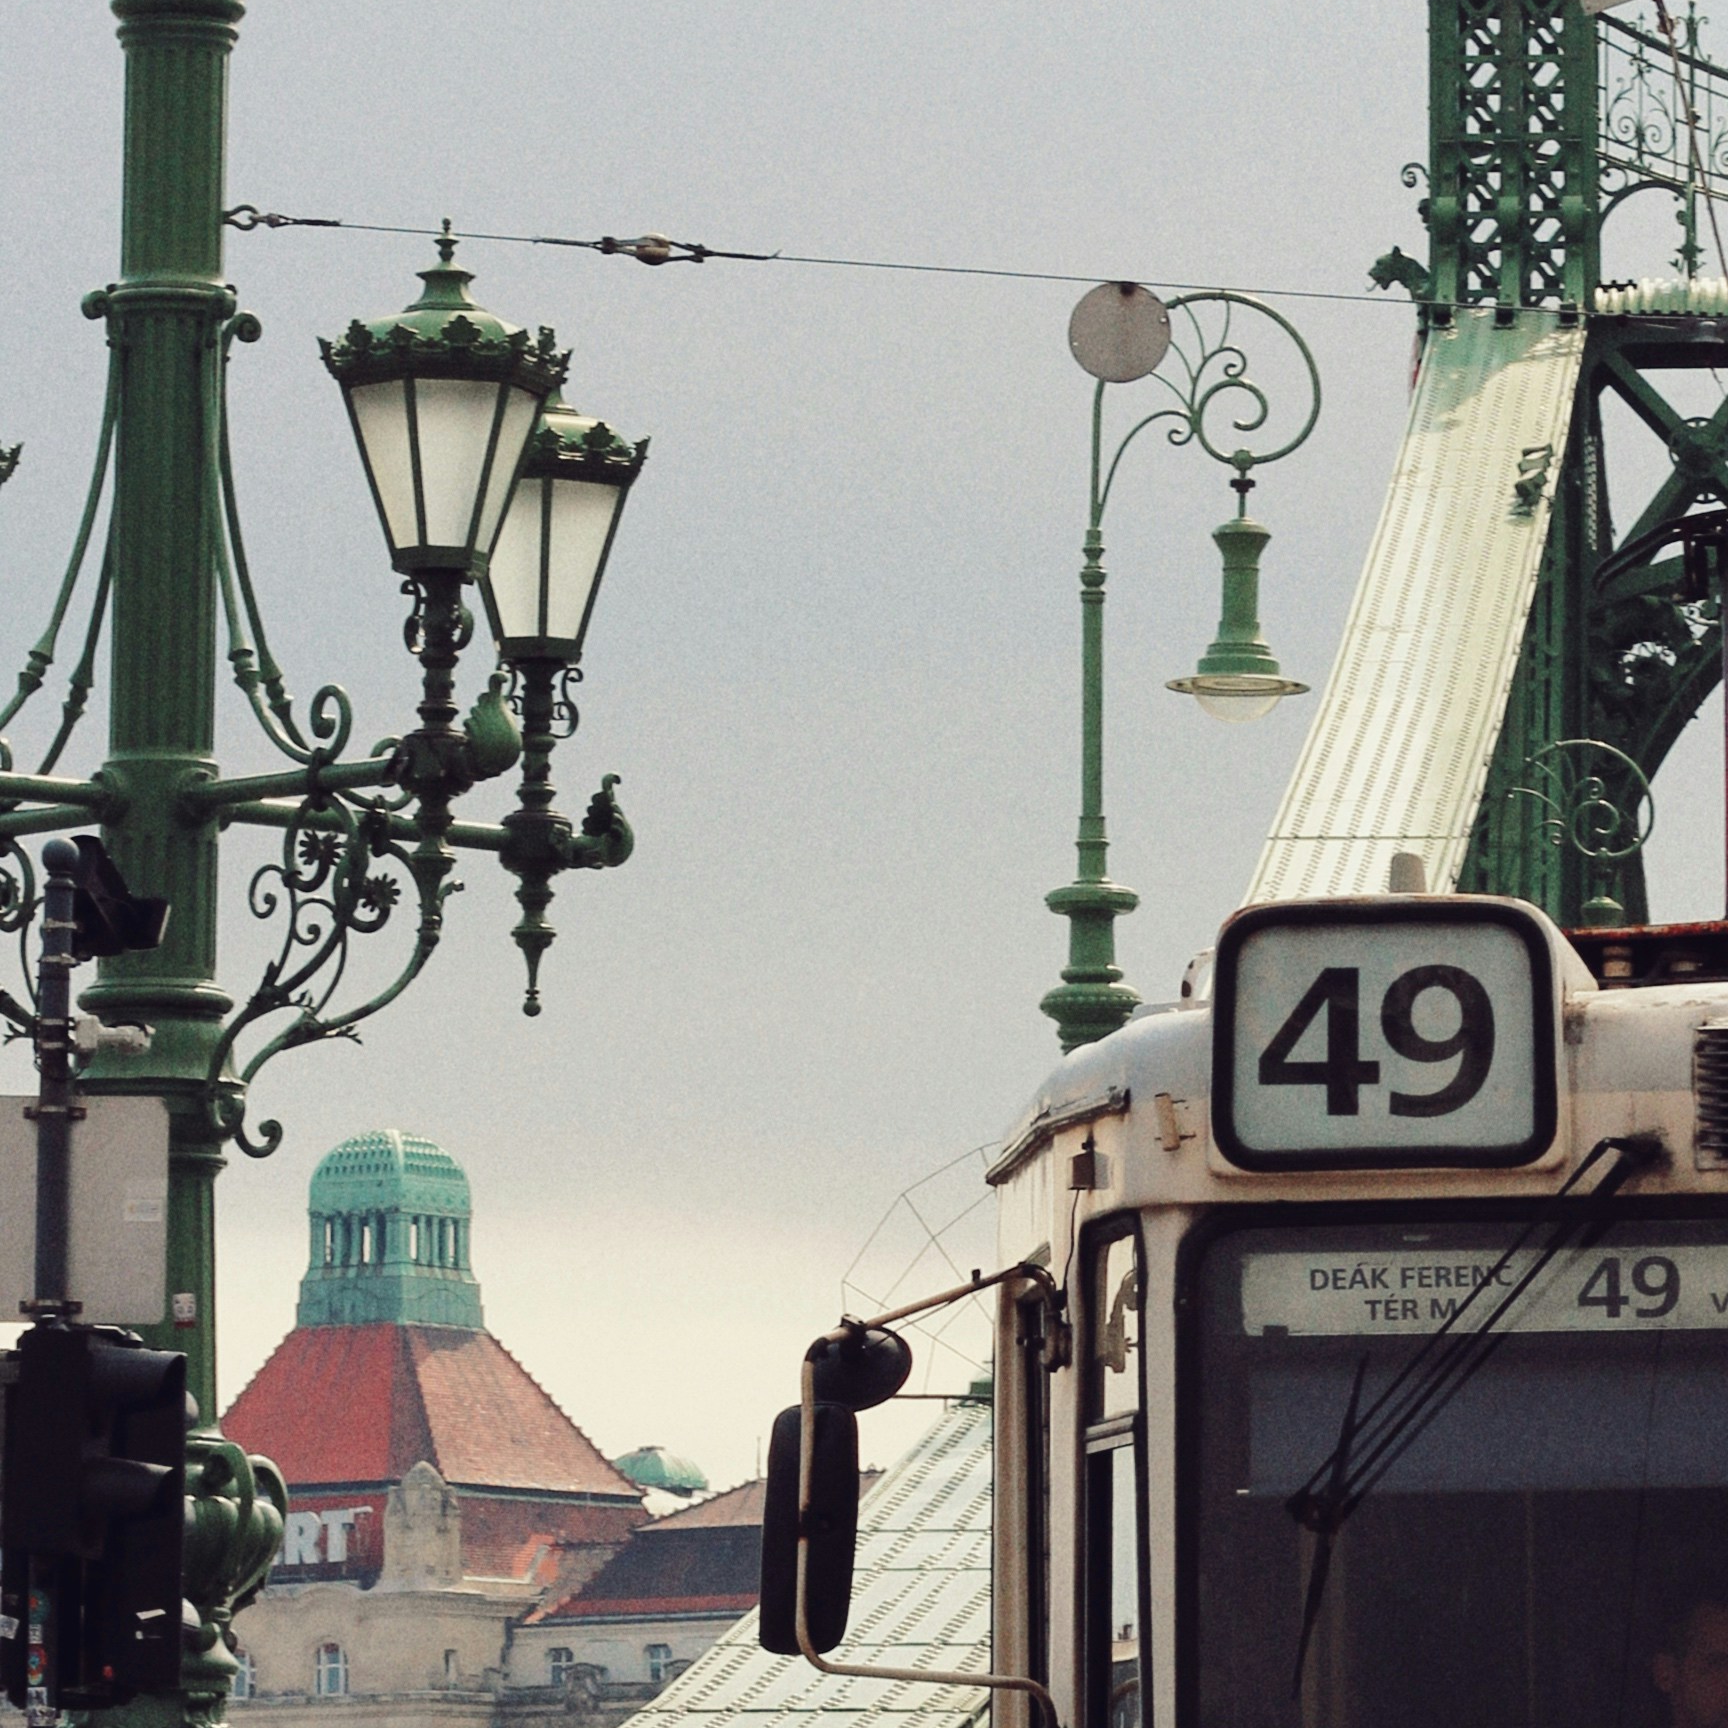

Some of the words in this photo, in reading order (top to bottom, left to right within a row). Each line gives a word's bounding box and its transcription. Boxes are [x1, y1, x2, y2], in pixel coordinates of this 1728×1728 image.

[1258, 964, 1496, 1118] 49
[1309, 1263, 1389, 1291] DEÁK
[1401, 1264, 1514, 1289] FERENC
[1577, 1256, 1681, 1319] 49
[1364, 1293, 1419, 1321] TÉR
[1430, 1297, 1458, 1320] M
[271, 1508, 356, 1566] RT
